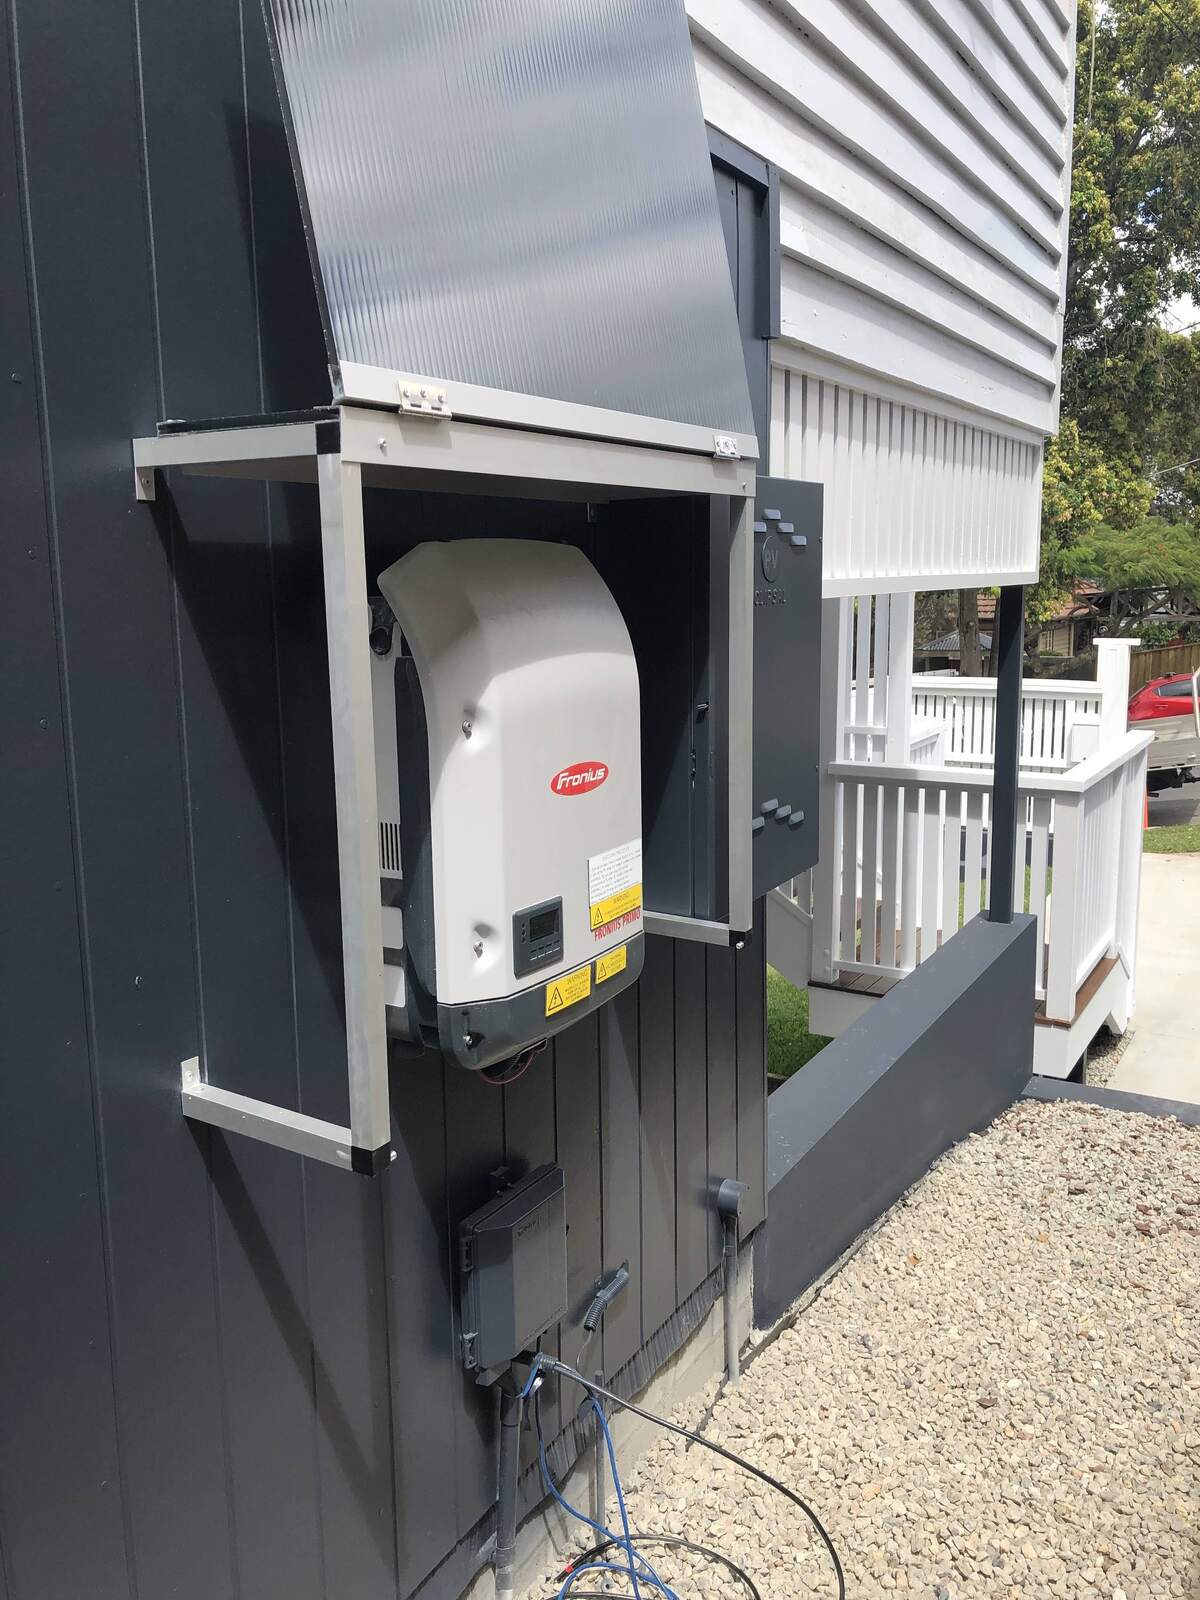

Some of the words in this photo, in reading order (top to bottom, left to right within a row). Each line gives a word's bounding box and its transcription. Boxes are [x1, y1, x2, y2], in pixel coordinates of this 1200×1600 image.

[556, 767, 605, 790] Fronius
[594, 920, 622, 941] FRONIUS
[622, 908, 641, 927] PRIMO
